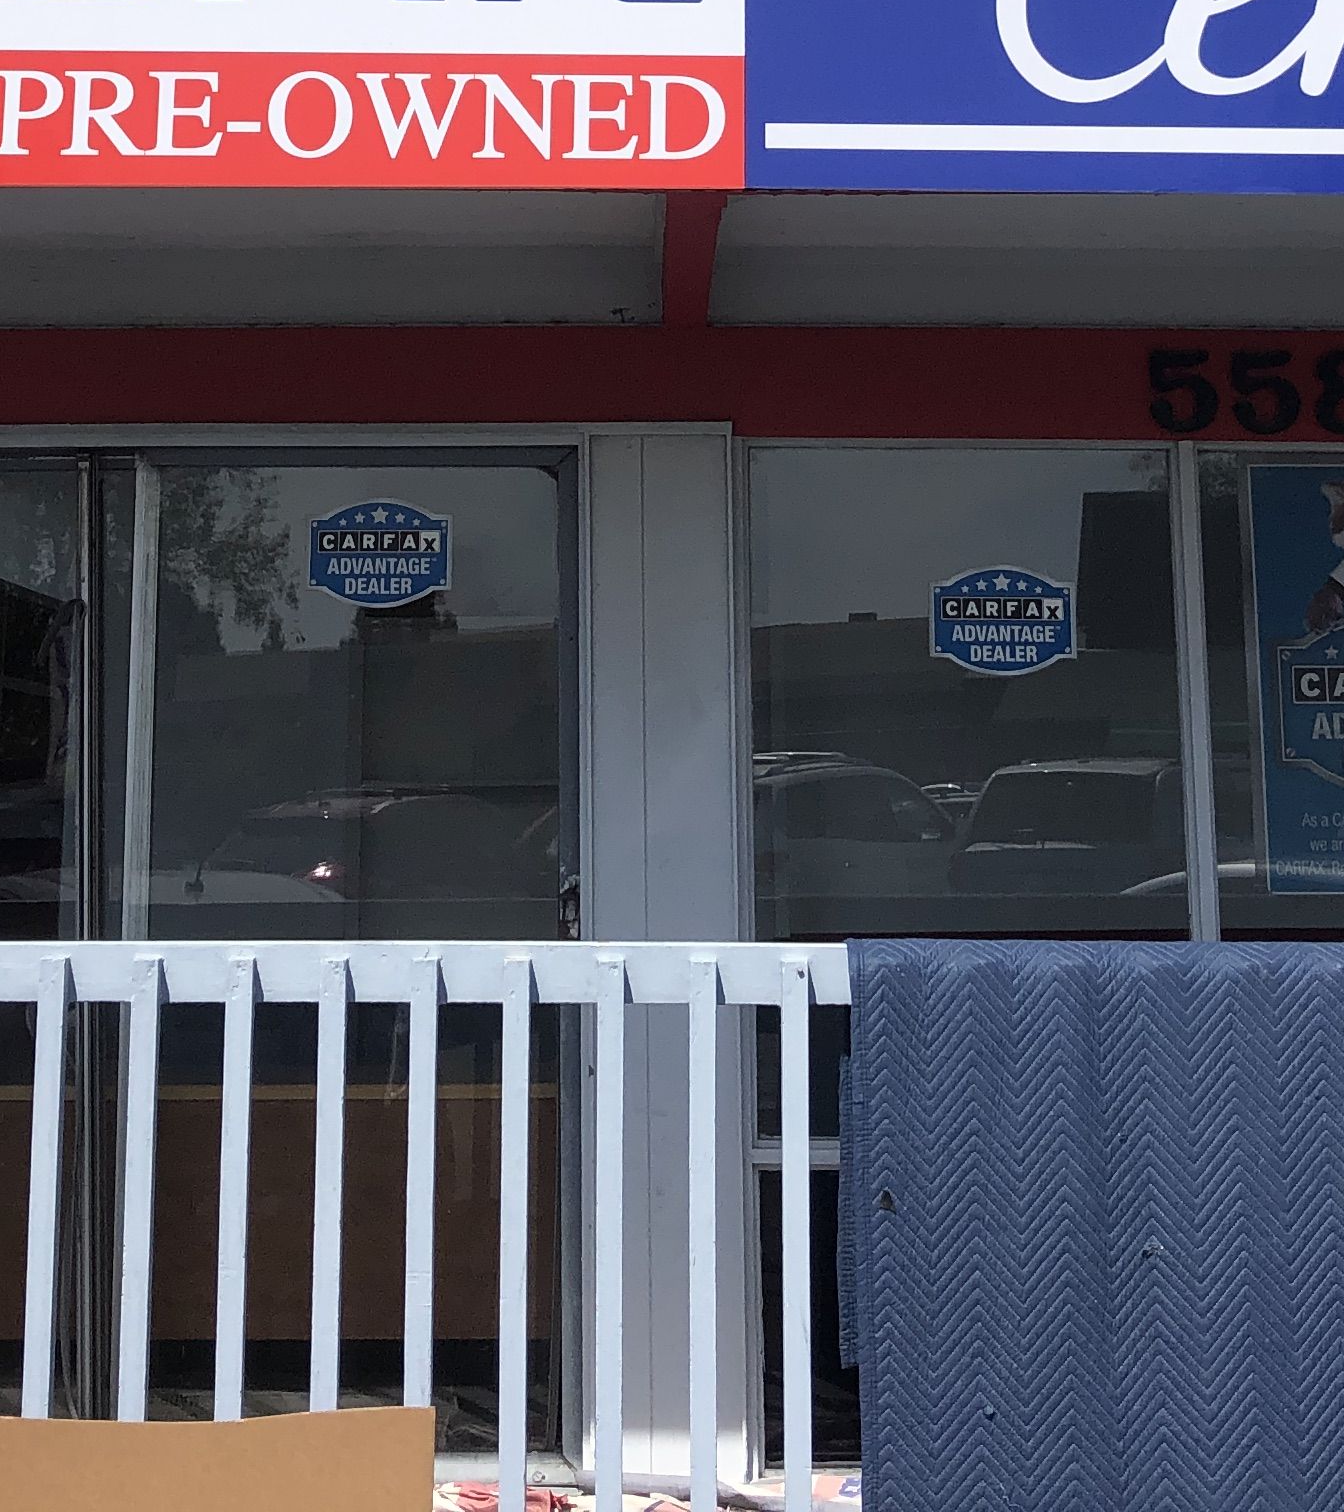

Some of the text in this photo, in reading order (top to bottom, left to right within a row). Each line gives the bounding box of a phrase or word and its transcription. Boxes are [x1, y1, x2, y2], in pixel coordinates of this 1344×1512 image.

[322, 533, 436, 552] CARFAX
[326, 557, 431, 575] ADVANTAGE
[344, 577, 413, 595] DEALER
[945, 600, 1060, 620] CARFAX
[951, 624, 1056, 643] ADVANTAGE
[969, 644, 1038, 663] DEALER
[1301, 812, 1317, 829] As
[1321, 817, 1329, 828] a
[1309, 840, 1328, 852] we
